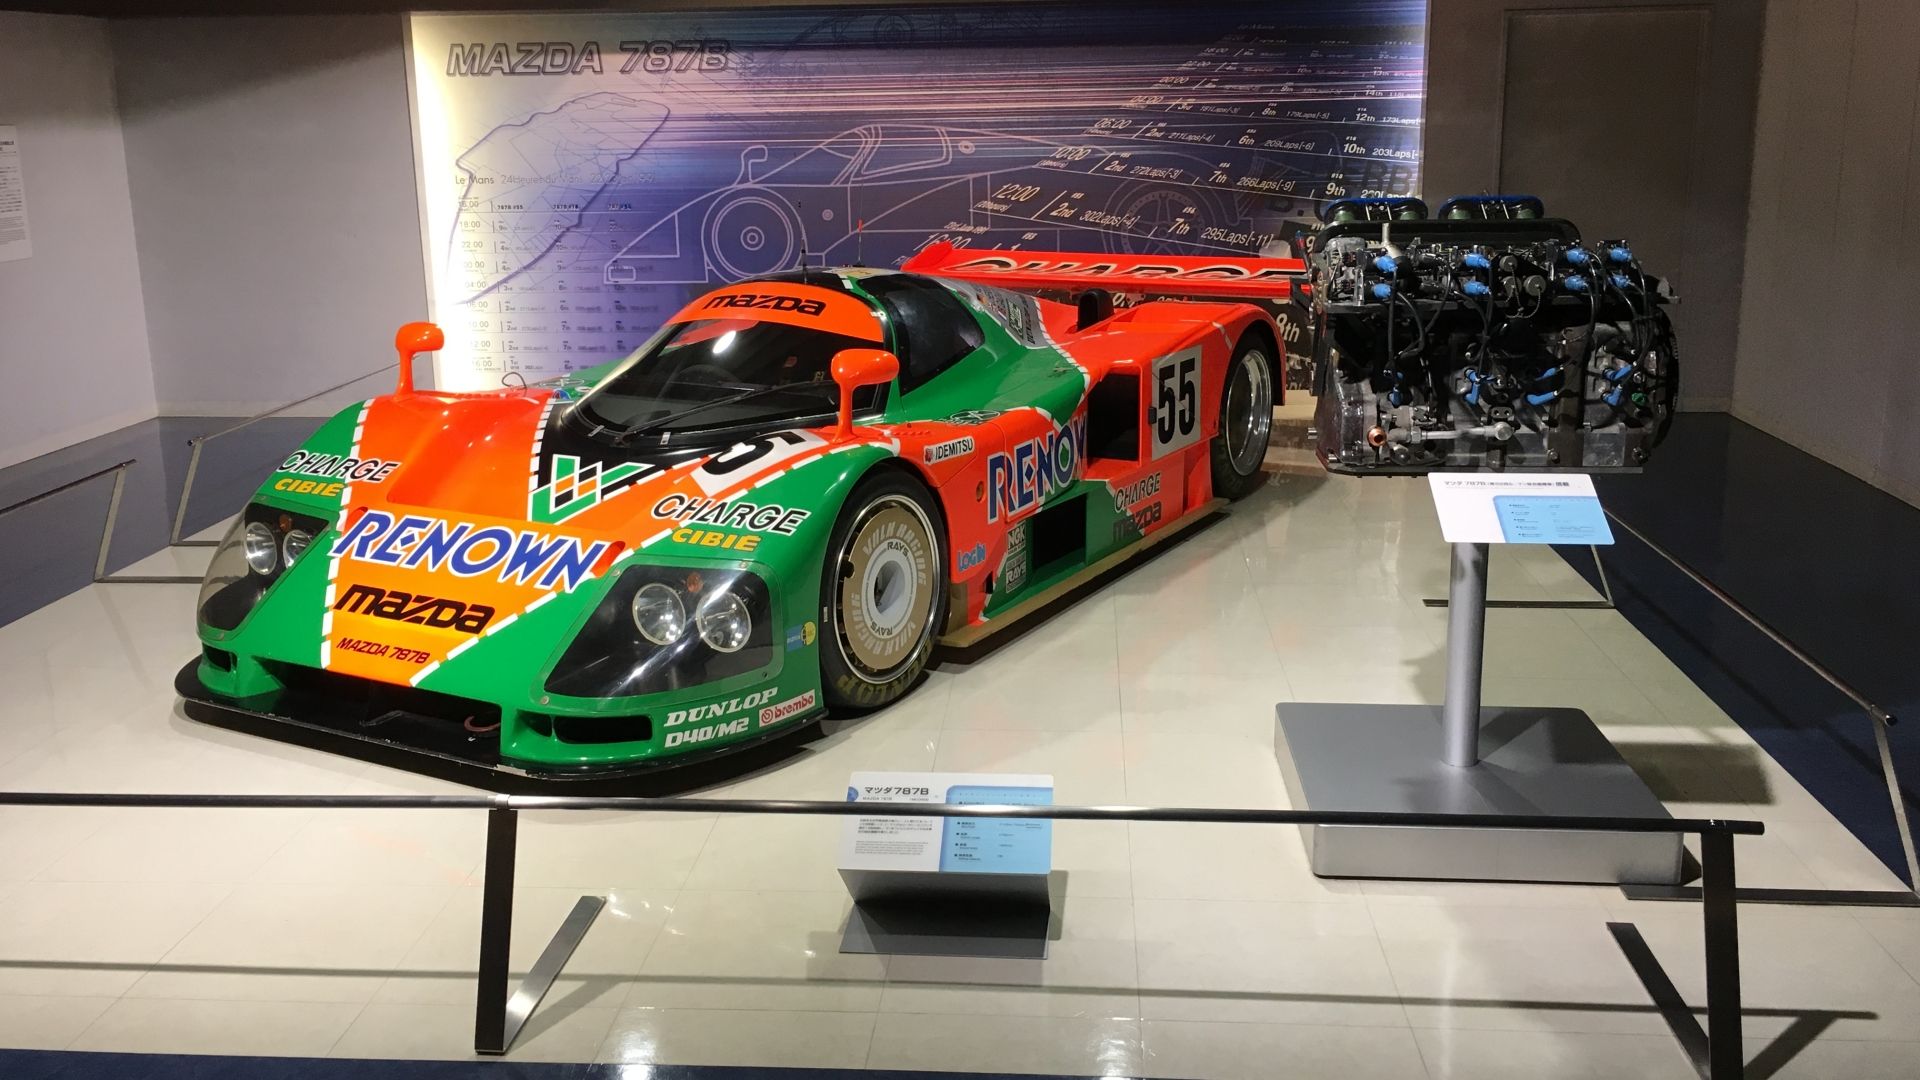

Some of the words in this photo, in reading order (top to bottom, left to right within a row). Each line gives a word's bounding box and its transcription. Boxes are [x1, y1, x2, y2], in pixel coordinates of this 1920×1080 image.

[447, 40, 602, 76] MAZDA
[619, 39, 731, 75] 787B
[1094, 118, 1132, 129] 06:00
[1355, 113, 1376, 122] 12th
[1145, 128, 1165, 138] 2nd
[1238, 135, 1255, 146] 6th
[1049, 147, 1091, 160] 10:00
[1343, 142, 1366, 155] 10th
[1104, 160, 1127, 173] 2nd
[1208, 170, 1228, 184] 7th
[469, 175, 494, 184] Mans
[1325, 182, 1346, 197] 9th
[992, 183, 1041, 202] 12:00
[1049, 202, 1078, 218] 2nd
[1079, 210, 1141, 229] 302Laps[-4]
[1168, 217, 1190, 235] 7th
[1201, 226, 1274, 249] 295Laps[-11]
[702, 292, 827, 317] mazda
[1157, 357, 1197, 445] 55
[935, 437, 974, 460] IDEMITSU
[277, 450, 402, 484] CHARGE
[1114, 471, 1162, 513] CHARGE
[650, 493, 812, 536] CHARGE
[1112, 500, 1162, 543] mazda
[886, 541, 909, 557] RAYS
[1008, 525, 1025, 549] NGK
[328, 508, 613, 593] RENOWN
[333, 583, 496, 635] mazda
[336, 637, 390, 657] MAZDA
[389, 647, 431, 664] 787B
[663, 686, 778, 727] DUNLOP
[774, 694, 814, 719] brembo
[664, 717, 749, 748] D40/M2
[864, 786, 929, 796] マツダ787B
